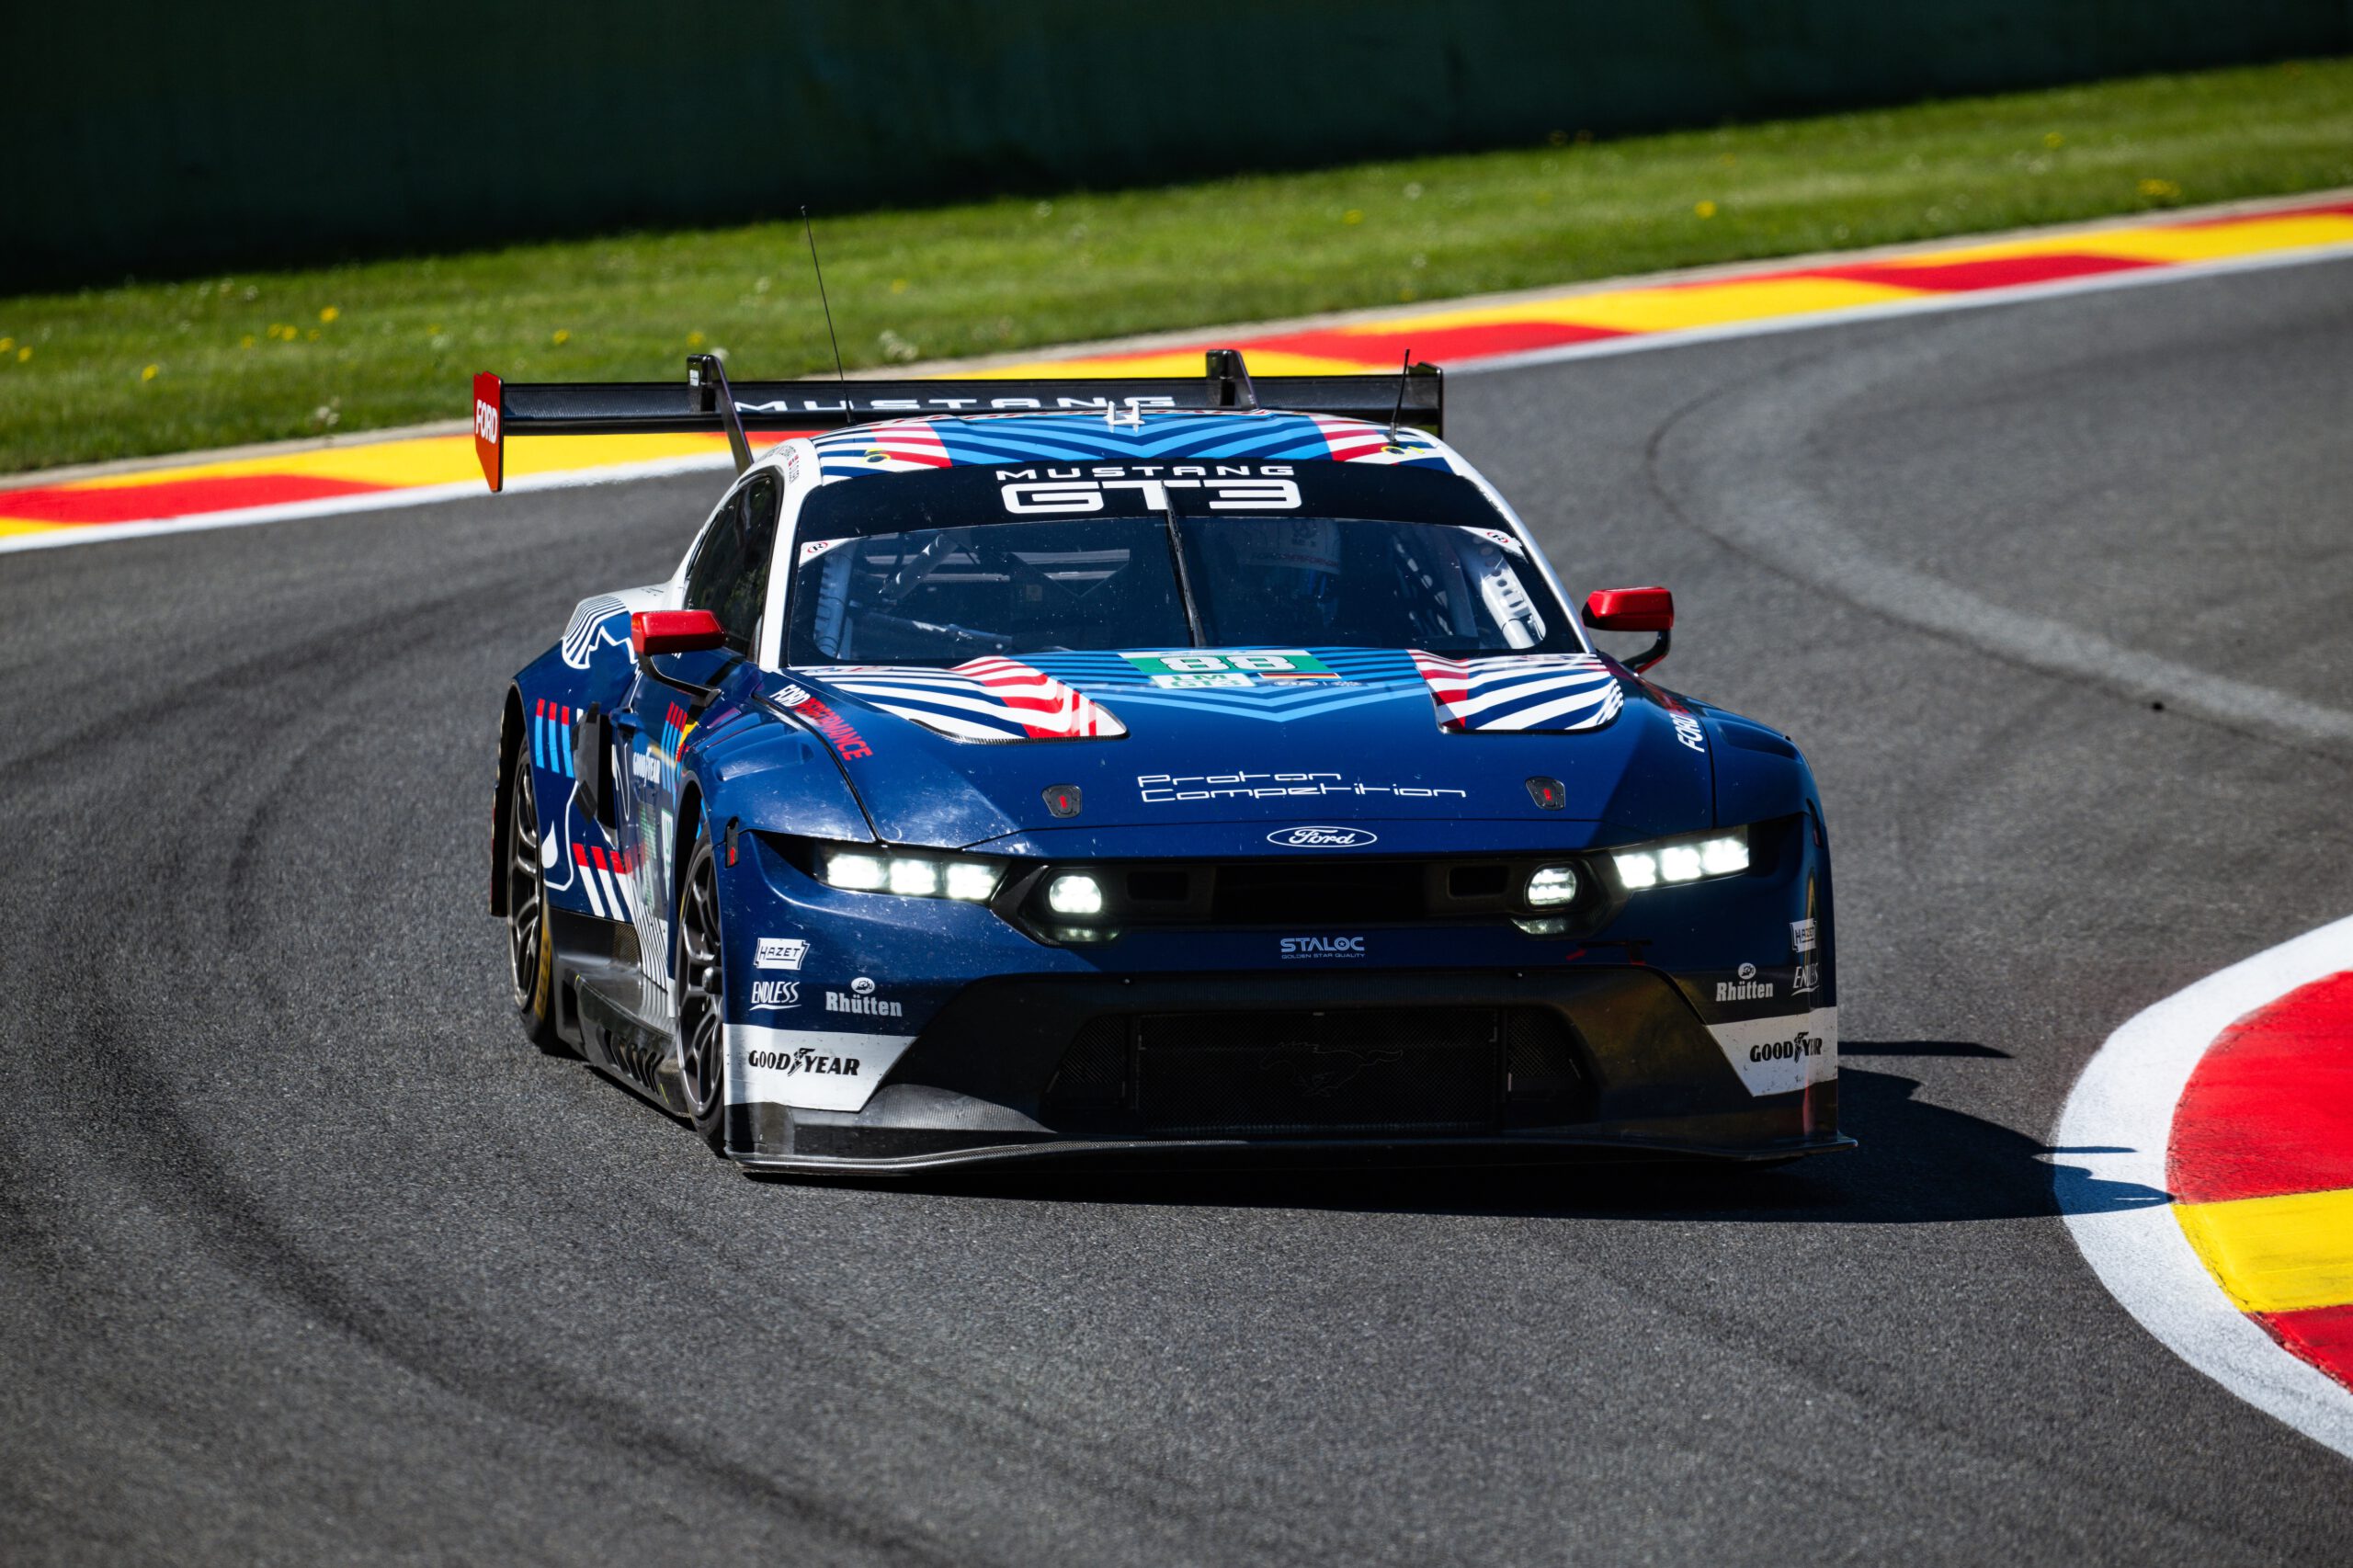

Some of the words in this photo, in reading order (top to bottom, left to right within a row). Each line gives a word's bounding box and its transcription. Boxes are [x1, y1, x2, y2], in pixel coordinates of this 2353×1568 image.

[734, 396, 1176, 412] MUSTANG
[475, 399, 498, 445] FORD
[995, 464, 1295, 481] MUSTANG
[1001, 479, 1302, 515] GT3
[1158, 655, 1296, 672] 88
[768, 684, 811, 707] FORD
[1669, 712, 1705, 753] FORD
[1137, 770, 1342, 788] Proton
[1141, 782, 1467, 802] Competition
[1288, 827, 1357, 845] Ford
[759, 945, 801, 961] HAZET
[1279, 937, 1366, 953] STALOC
[751, 981, 801, 1005] ENDLESS
[1715, 977, 1774, 1002] Rhütten
[825, 991, 903, 1017] Rhütten
[748, 1048, 860, 1076] GOODYEAR
